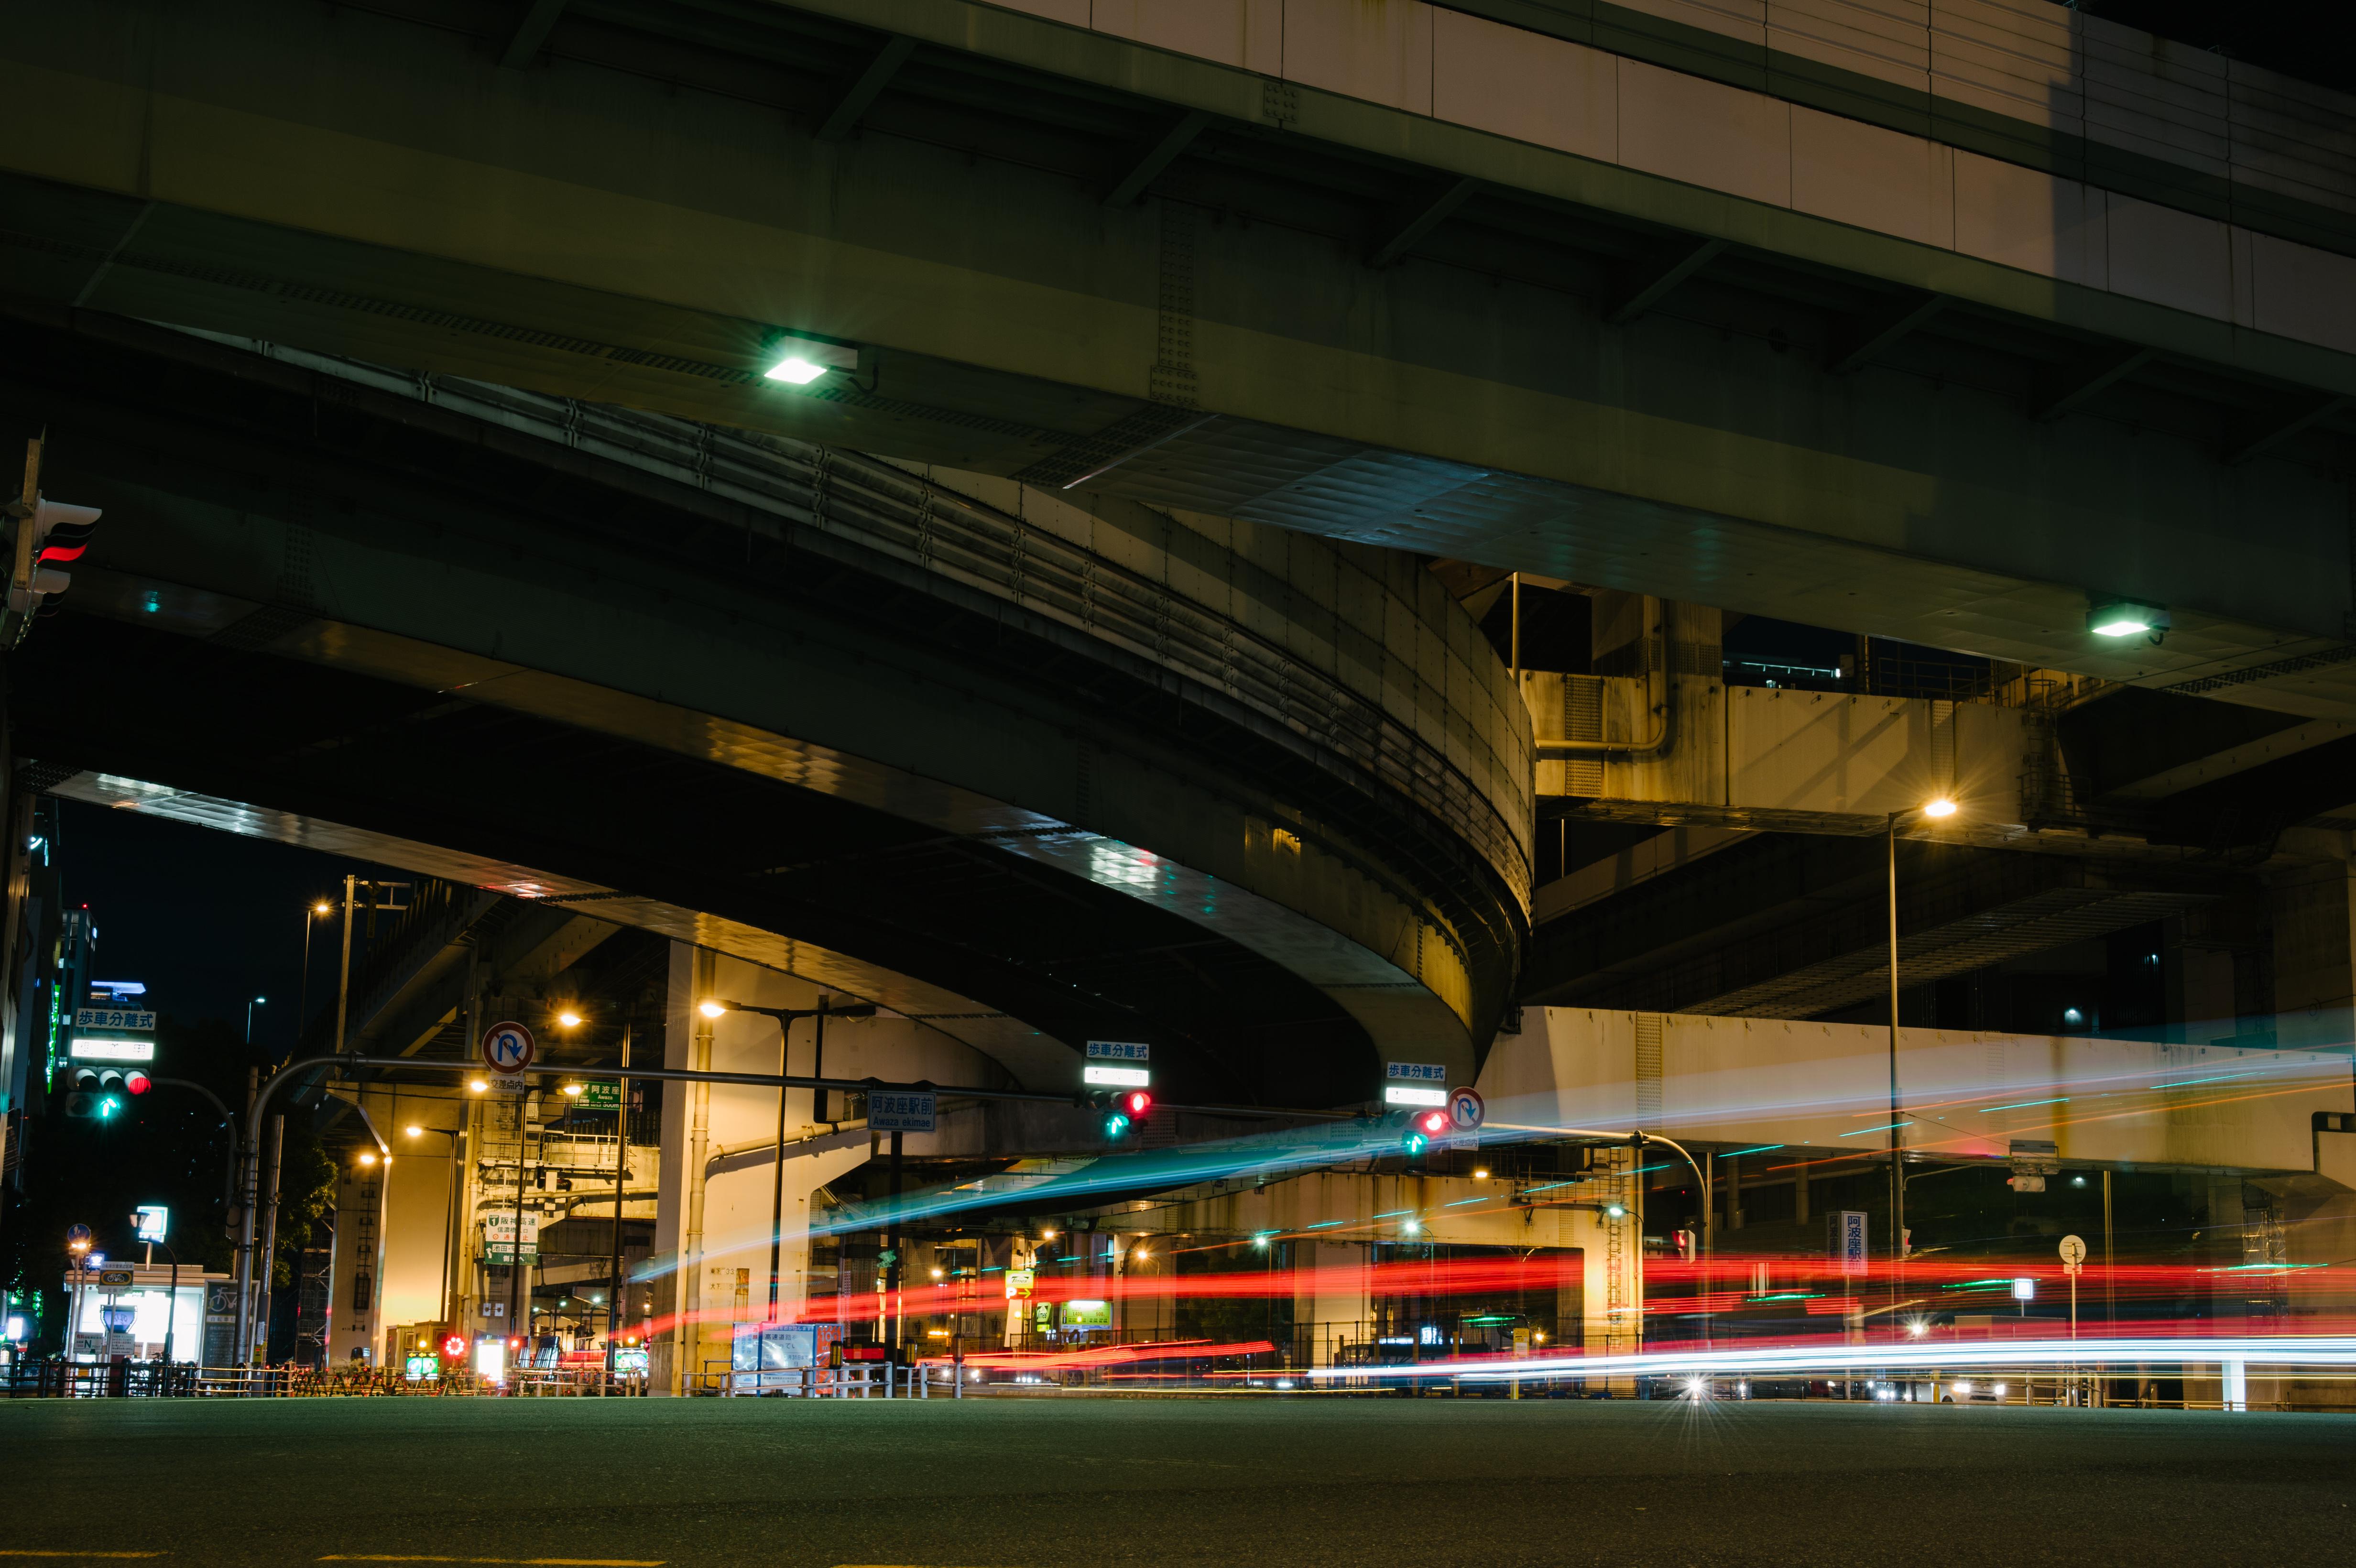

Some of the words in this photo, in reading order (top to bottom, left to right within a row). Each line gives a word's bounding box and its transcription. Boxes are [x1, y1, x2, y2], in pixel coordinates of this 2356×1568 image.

[78, 1010, 153, 1028] 歩車分離式
[1089, 1043, 1147, 1058] 歩車分離式
[1389, 1064, 1444, 1079] 歩車分離式
[491, 1078, 523, 1090] 交差点内
[591, 1085, 620, 1095] 阿波座
[872, 1096, 933, 1115] 阿波座駅前
[873, 1116, 899, 1126] Awaza
[902, 1117, 930, 1127] ekimae
[1452, 1137, 1477, 1147] 交差点内
[501, 1217, 536, 1226] 阪神高速
[1847, 1216, 1862, 1270] 阿波座駅前
[1006, 1286, 1017, 1299] P
